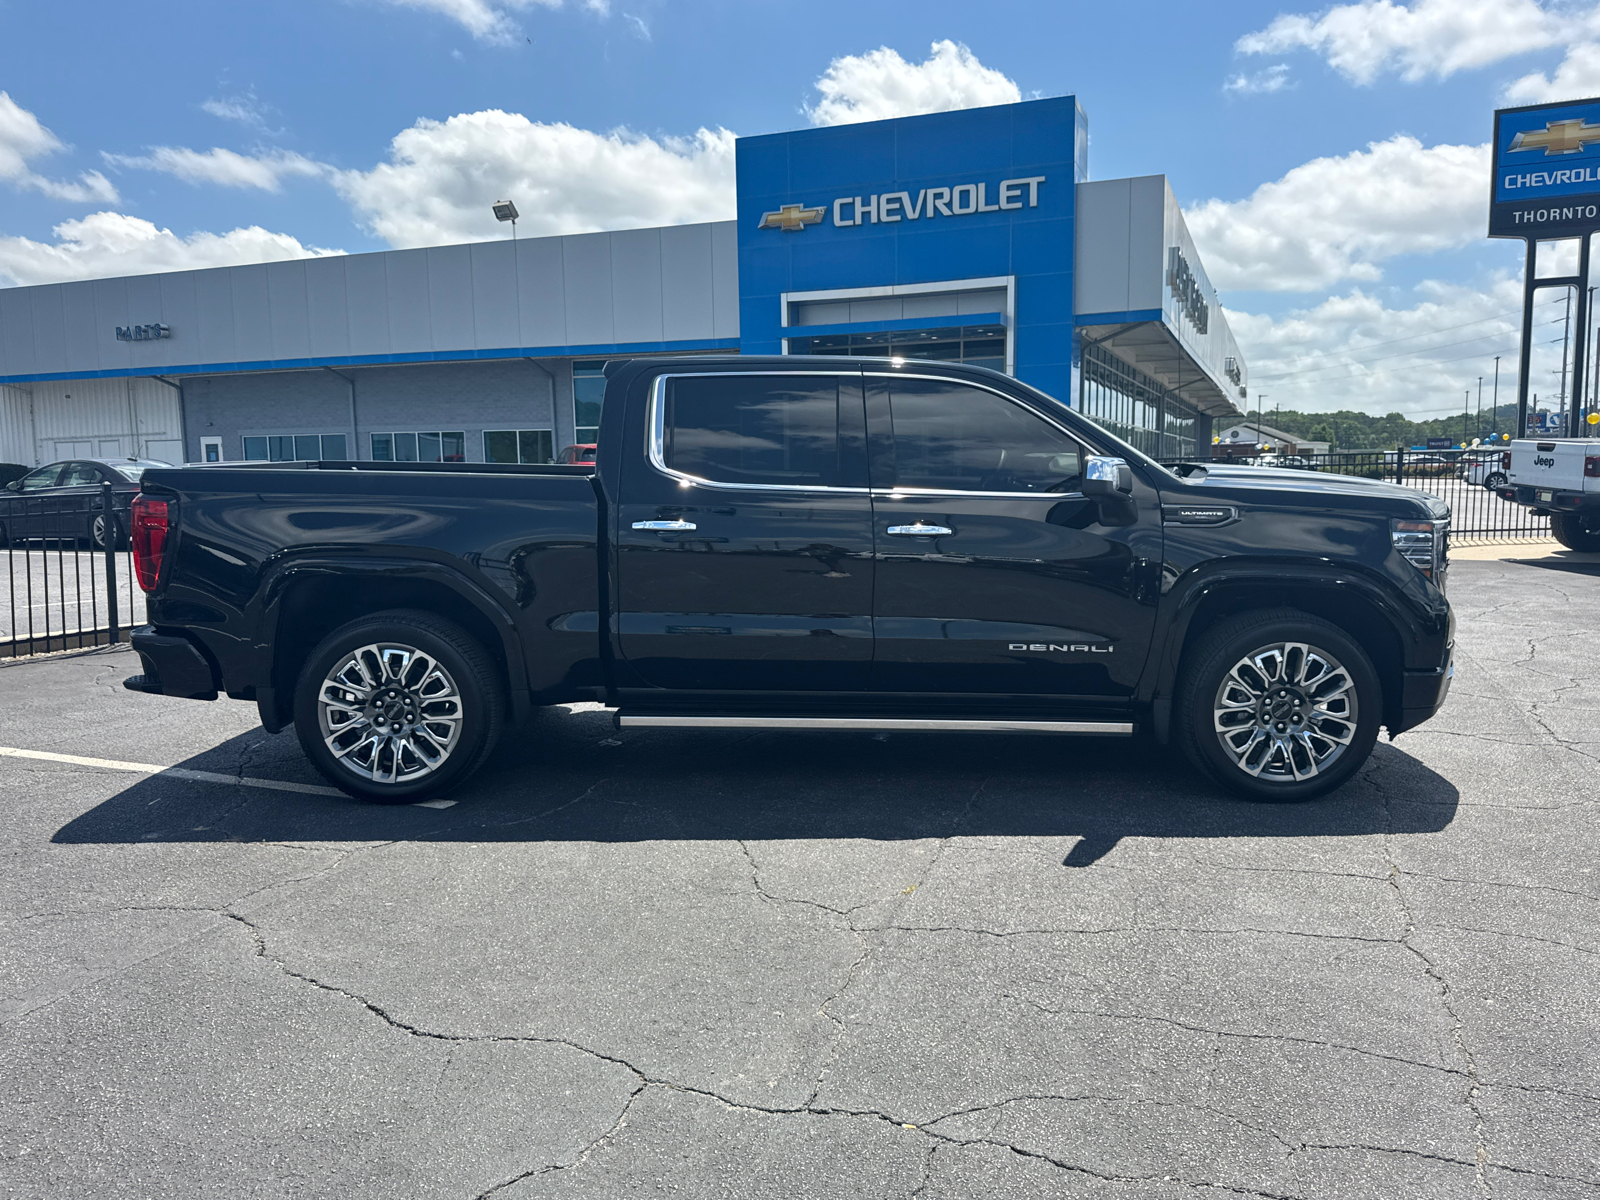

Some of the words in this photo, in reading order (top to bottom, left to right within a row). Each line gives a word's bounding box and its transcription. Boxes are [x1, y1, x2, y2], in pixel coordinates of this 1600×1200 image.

[1504, 167, 1600, 189] CHEVROL
[833, 176, 1046, 227] CHEVROLET
[1513, 205, 1600, 224] THORNTO
[115, 323, 164, 341] PARTS
[1534, 455, 1555, 468] Jeep
[1008, 643, 1114, 653] DENALI
